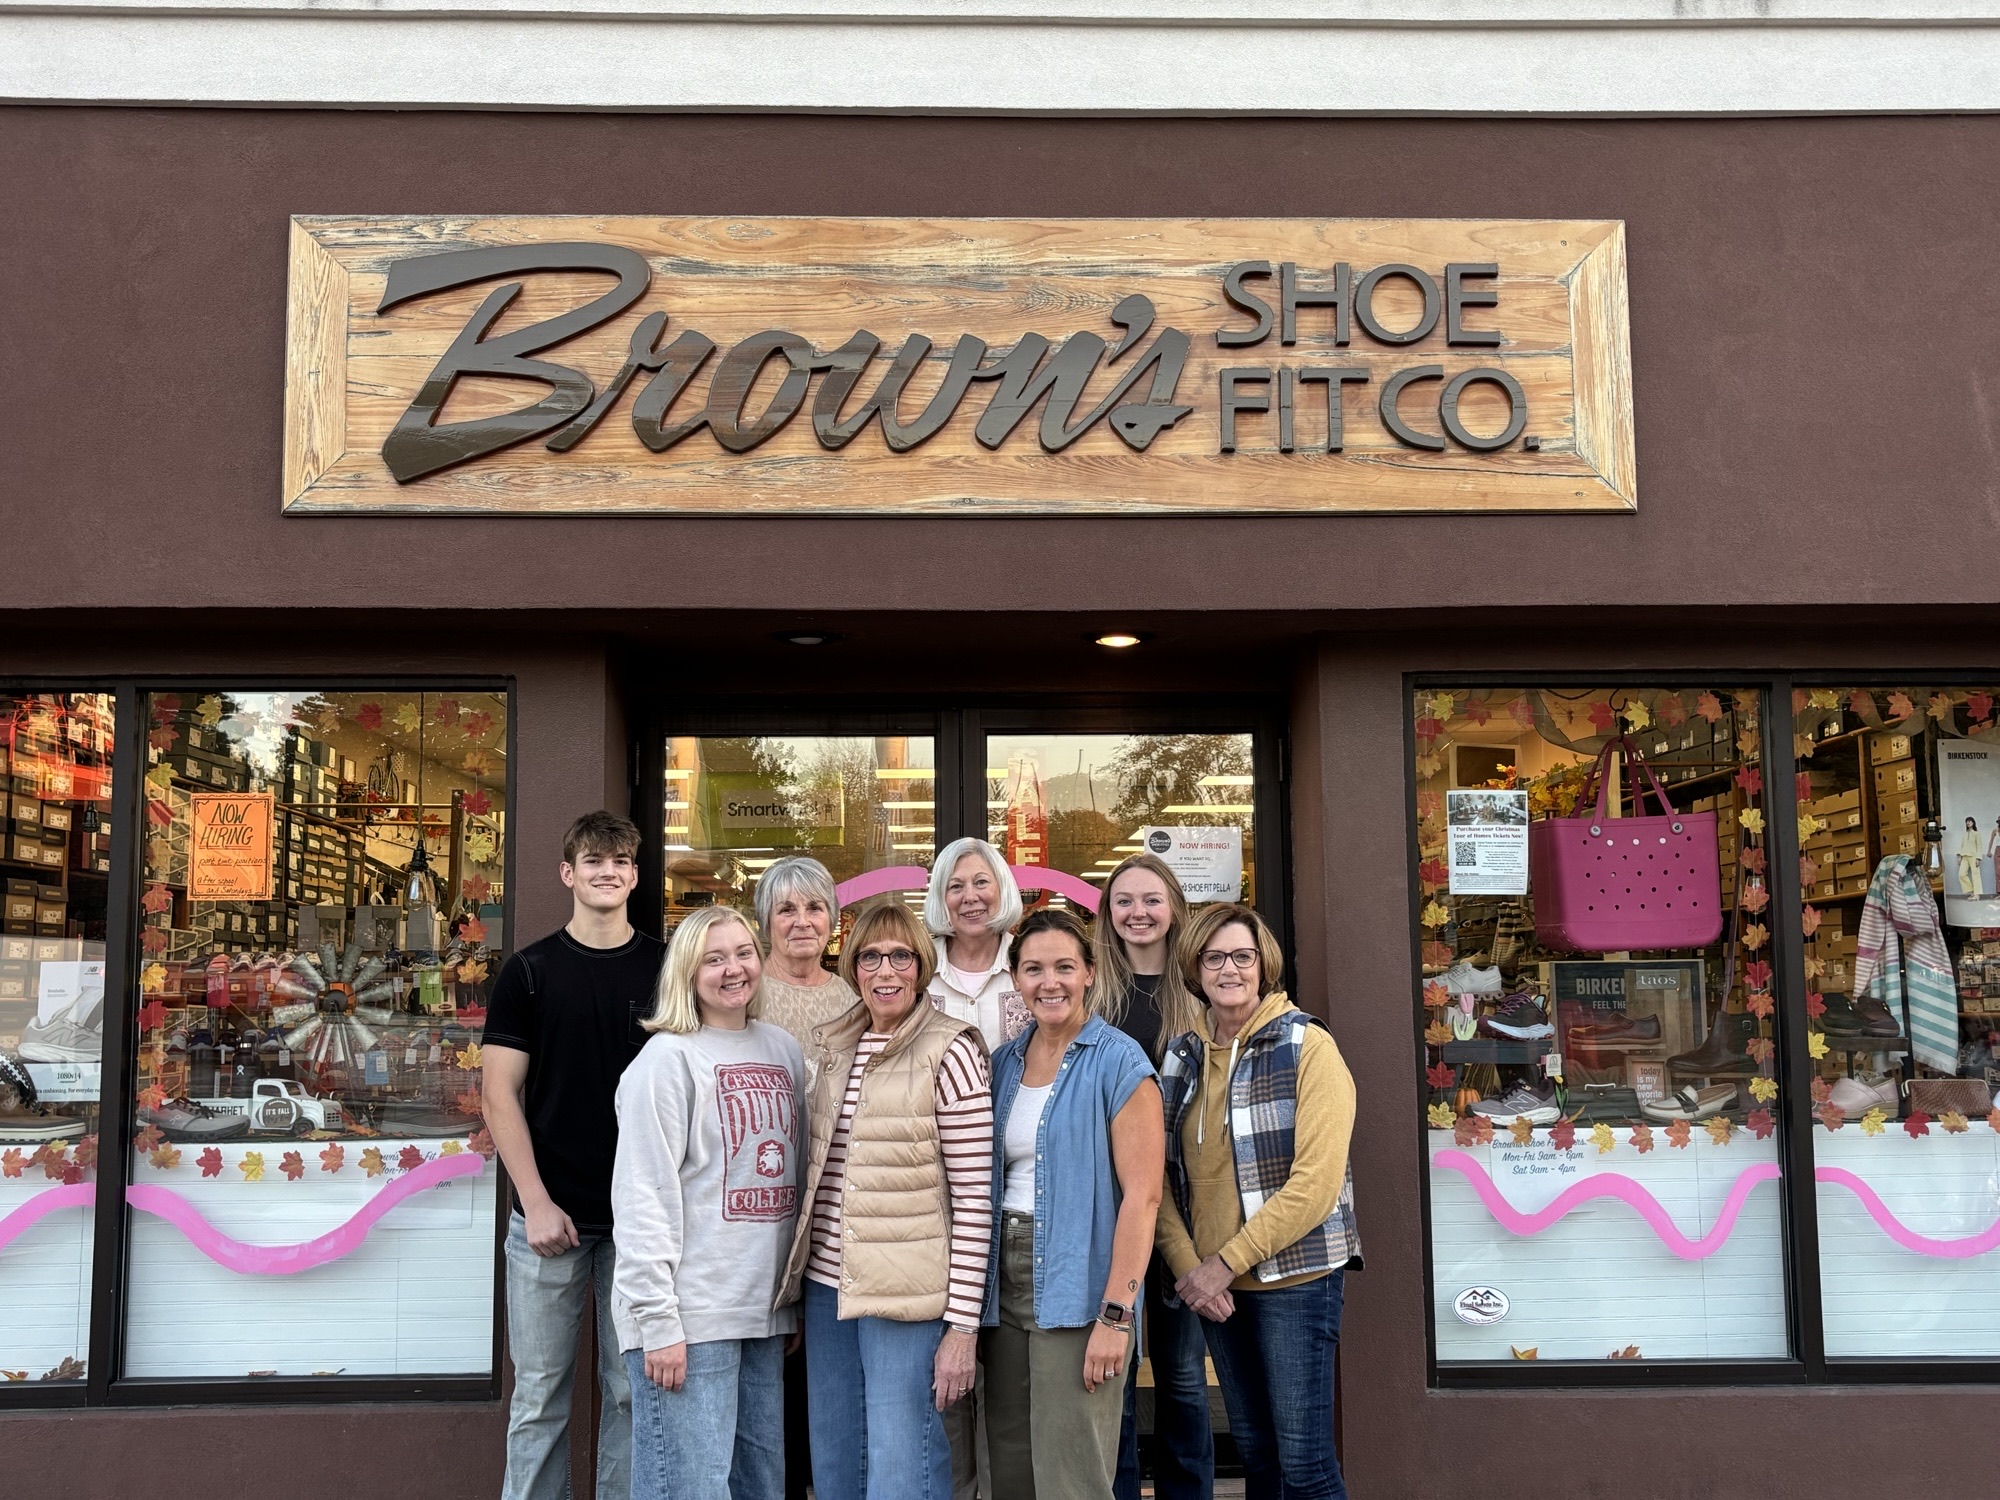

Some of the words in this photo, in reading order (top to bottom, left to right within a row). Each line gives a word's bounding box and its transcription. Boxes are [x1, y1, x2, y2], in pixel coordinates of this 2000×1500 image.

[1217, 260, 1500, 347] SHOE
[376, 241, 1193, 483] Brown's
[1220, 367, 1369, 453] FIT
[1378, 364, 1541, 453] CO.
[1947, 751, 1988, 760] BIRKENSTOCK
[211, 802, 252, 824] NOW
[200, 826, 253, 850] HIRING
[1188, 883, 1203, 892] SHOE
[1213, 883, 1231, 892] PELLA
[1592, 1000, 1611, 1010] FEEL
[1641, 1067, 1661, 1077] today
[723, 1072, 793, 1091] CENTRAL
[1646, 1077, 1657, 1085] my
[1636, 1091, 1663, 1099] avorite
[266, 1108, 277, 1116] IT'S
[278, 1107, 291, 1115] FALL
[723, 1090, 798, 1161] DUTCH
[1502, 1151, 1536, 1162] Mon-Fri
[1537, 1151, 1557, 1161] 9am
[1566, 1150, 1585, 1161] 6pm
[1512, 1165, 1528, 1175] Sat
[1529, 1165, 1549, 1174] 9am
[1558, 1163, 1577, 1175] 4pm
